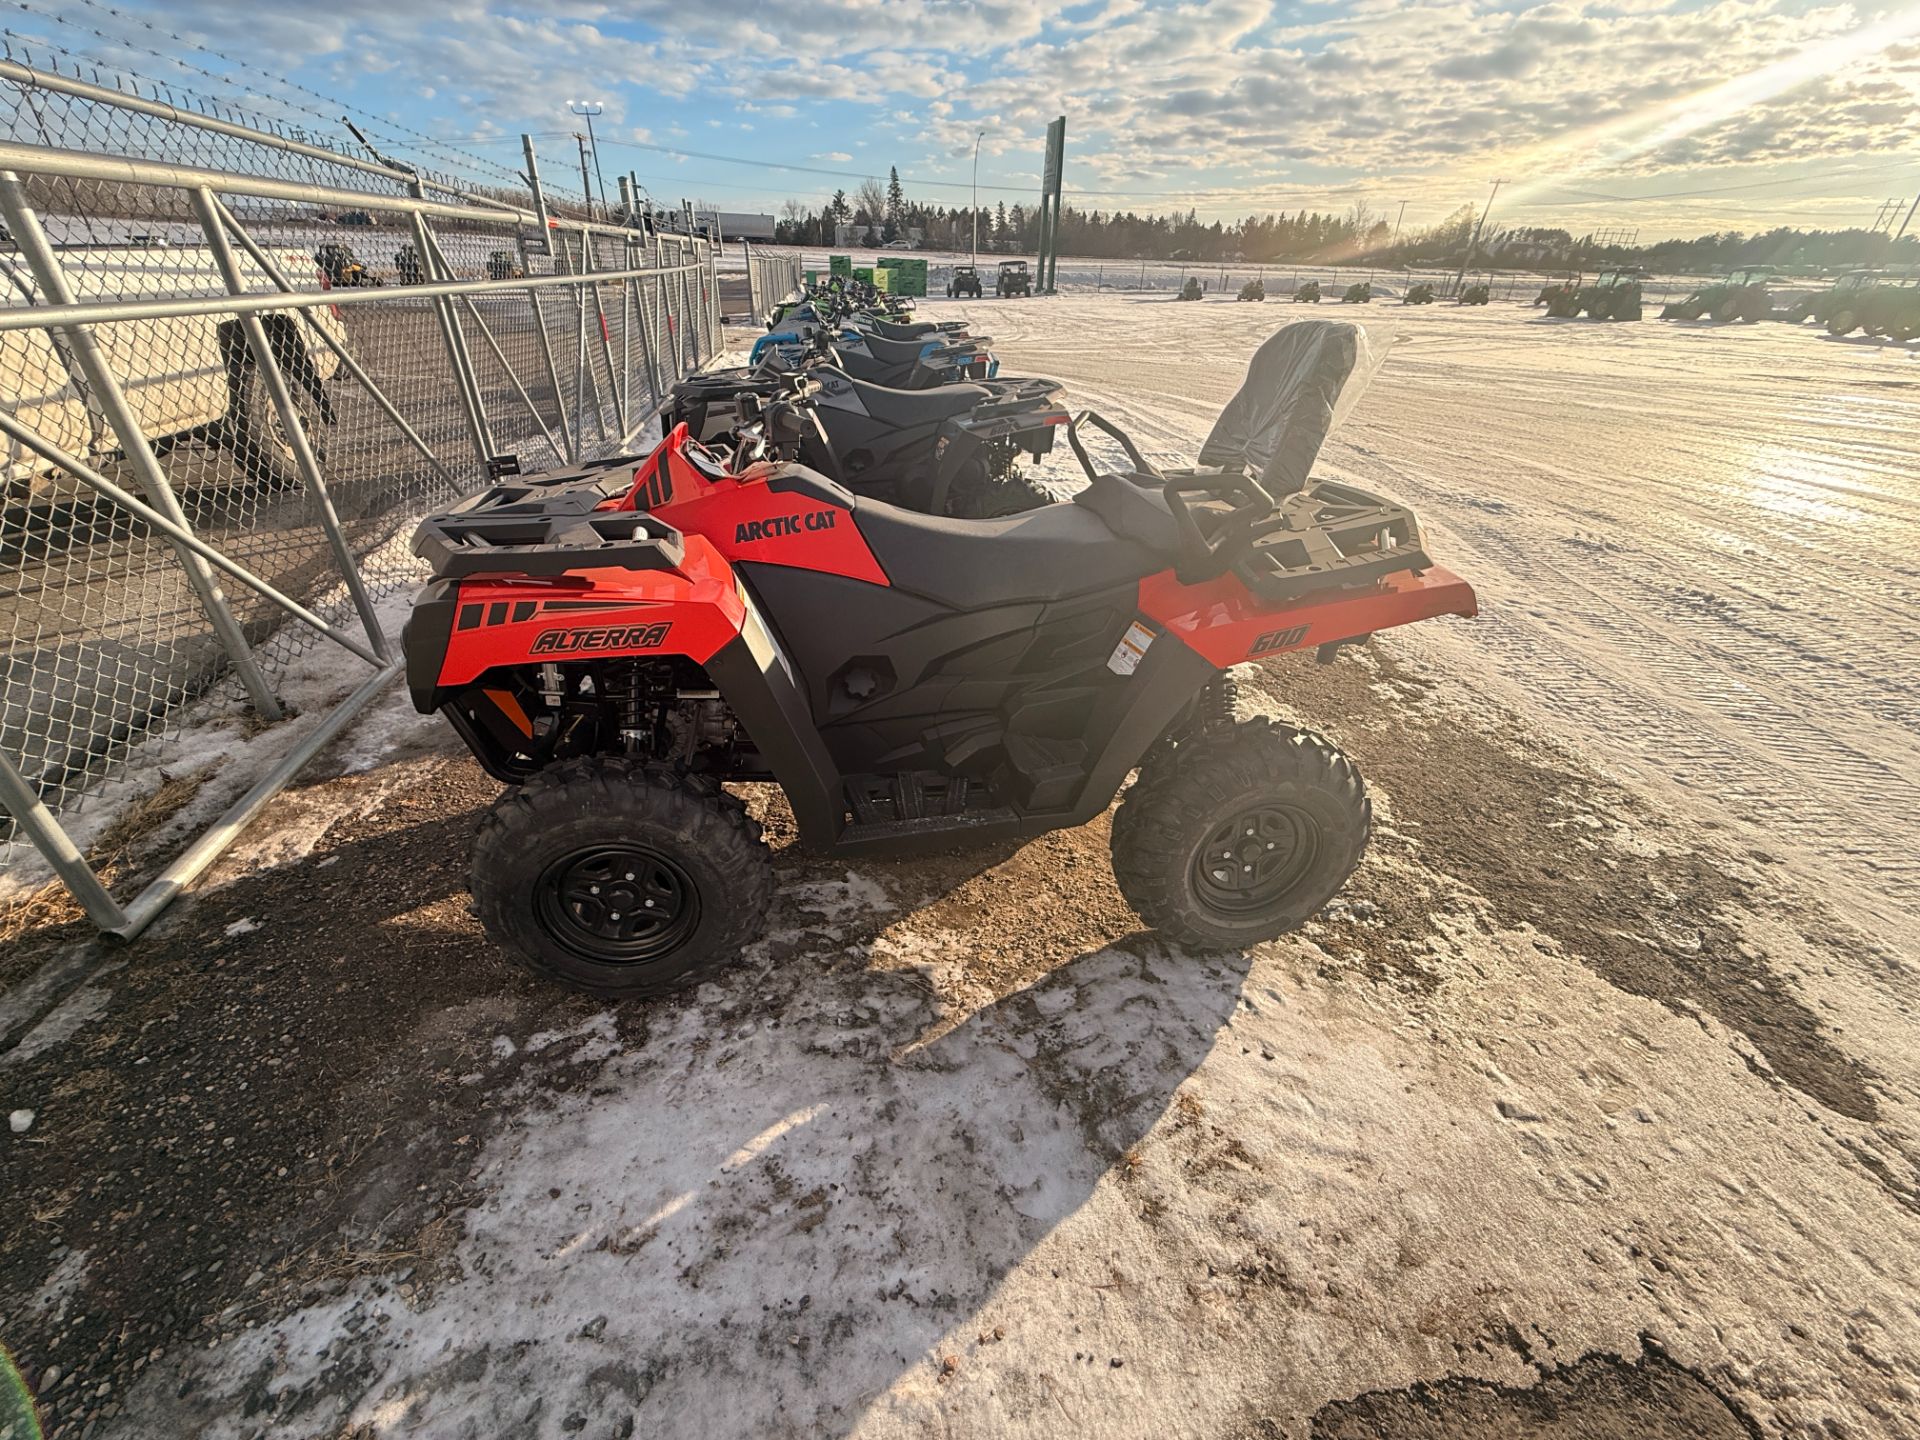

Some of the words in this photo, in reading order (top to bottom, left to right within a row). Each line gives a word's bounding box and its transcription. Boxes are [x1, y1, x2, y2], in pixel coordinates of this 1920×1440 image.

[735, 514, 801, 544] ARCTIC
[804, 510, 836, 531] CAT
[531, 622, 671, 653] ALTERRA
[1249, 624, 1312, 655] 600
